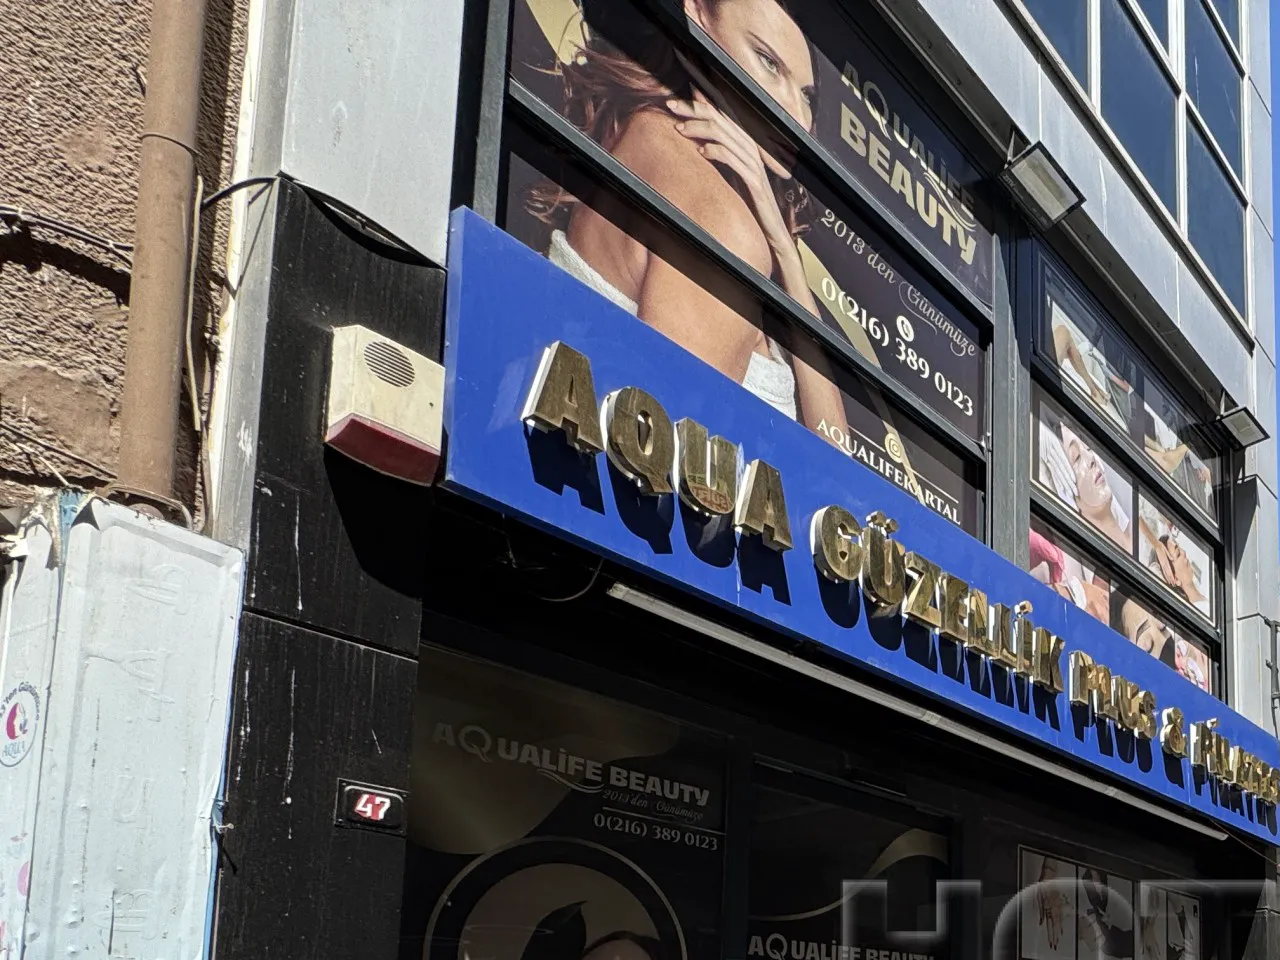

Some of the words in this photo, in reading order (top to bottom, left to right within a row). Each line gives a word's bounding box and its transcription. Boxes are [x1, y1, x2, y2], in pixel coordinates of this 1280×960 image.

[841, 103, 977, 265] BEAUTY
[822, 277, 890, 348] 0(216)
[895, 339, 930, 379] 389
[934, 371, 974, 417] 0123
[520, 340, 794, 553] AQUA
[1160, 707, 1188, 758] &
[354, 794, 391, 821] 47
[609, 764, 710, 807] BEAUTY
[594, 813, 647, 837] 0(216)
[652, 825, 680, 843] 389
[685, 832, 718, 851] 0123
